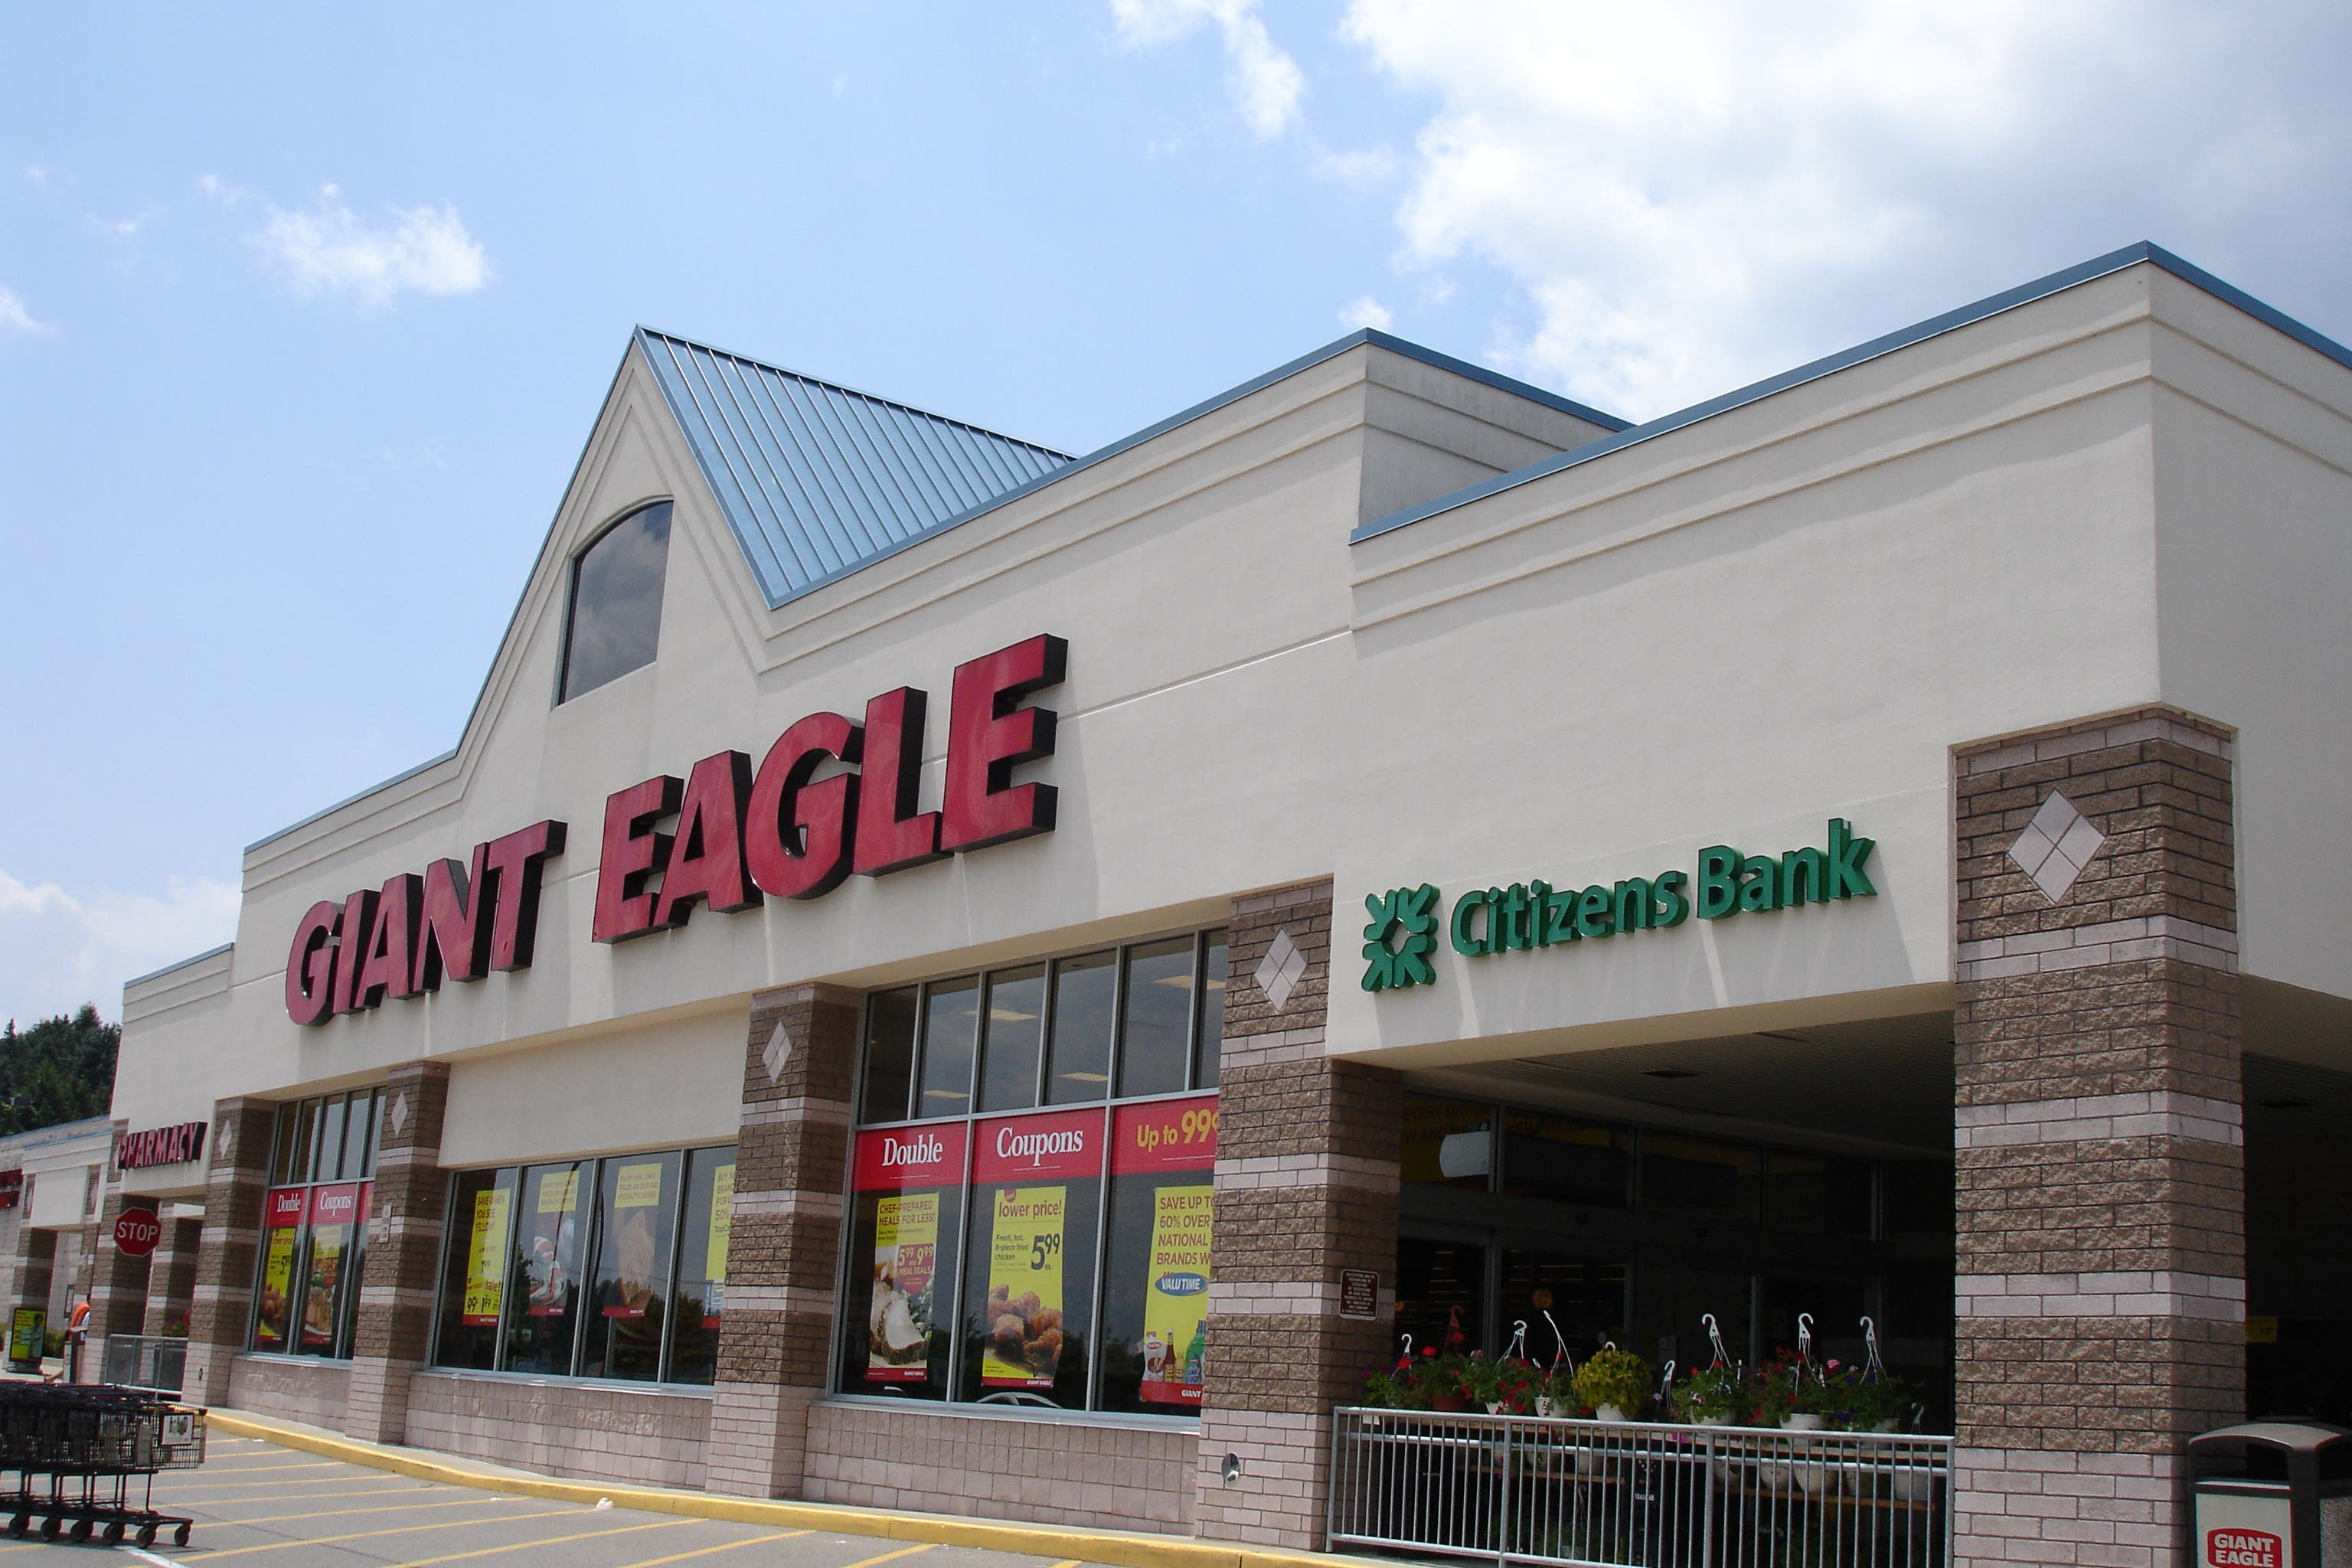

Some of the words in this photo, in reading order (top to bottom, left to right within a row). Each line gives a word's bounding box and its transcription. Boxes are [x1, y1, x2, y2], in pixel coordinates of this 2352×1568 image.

[285, 819, 567, 1026] GIANT
[592, 633, 1068, 943] EAGLE
[1451, 871, 1689, 956] Citizens
[1697, 818, 1877, 920] Bank
[118, 1122, 207, 1169] PHARMACY
[882, 1133, 942, 1166] Double
[997, 1127, 1083, 1167] Coupons
[1137, 1125, 1159, 1152] Up
[1163, 1125, 1178, 1145] to
[277, 1193, 300, 1212] Double
[320, 1191, 351, 1217] Coupons
[880, 1200, 933, 1214] CHEF-PREPARED
[998, 1201, 1030, 1217] lower
[1033, 1200, 1062, 1219] price!
[1160, 1197, 1186, 1210] SAVE
[1188, 1196, 1203, 1210] UP
[879, 1216, 900, 1226] MEALS
[902, 1214, 916, 1224] FOR
[917, 1213, 936, 1223] LESS!
[1160, 1215, 1181, 1228] 60%
[1183, 1214, 1210, 1228] OVER
[117, 1222, 158, 1242] STOP
[1158, 1233, 1208, 1246] NATIONAL
[1157, 1252, 1197, 1265] BRANDS
[1161, 1278, 1181, 1290] VALU
[1181, 1278, 1201, 1290] TIME
[1181, 1389, 1201, 1398] GIANT
[2214, 1533, 2274, 1551] GIANT
[2215, 1550, 2274, 1567] EAGLE
